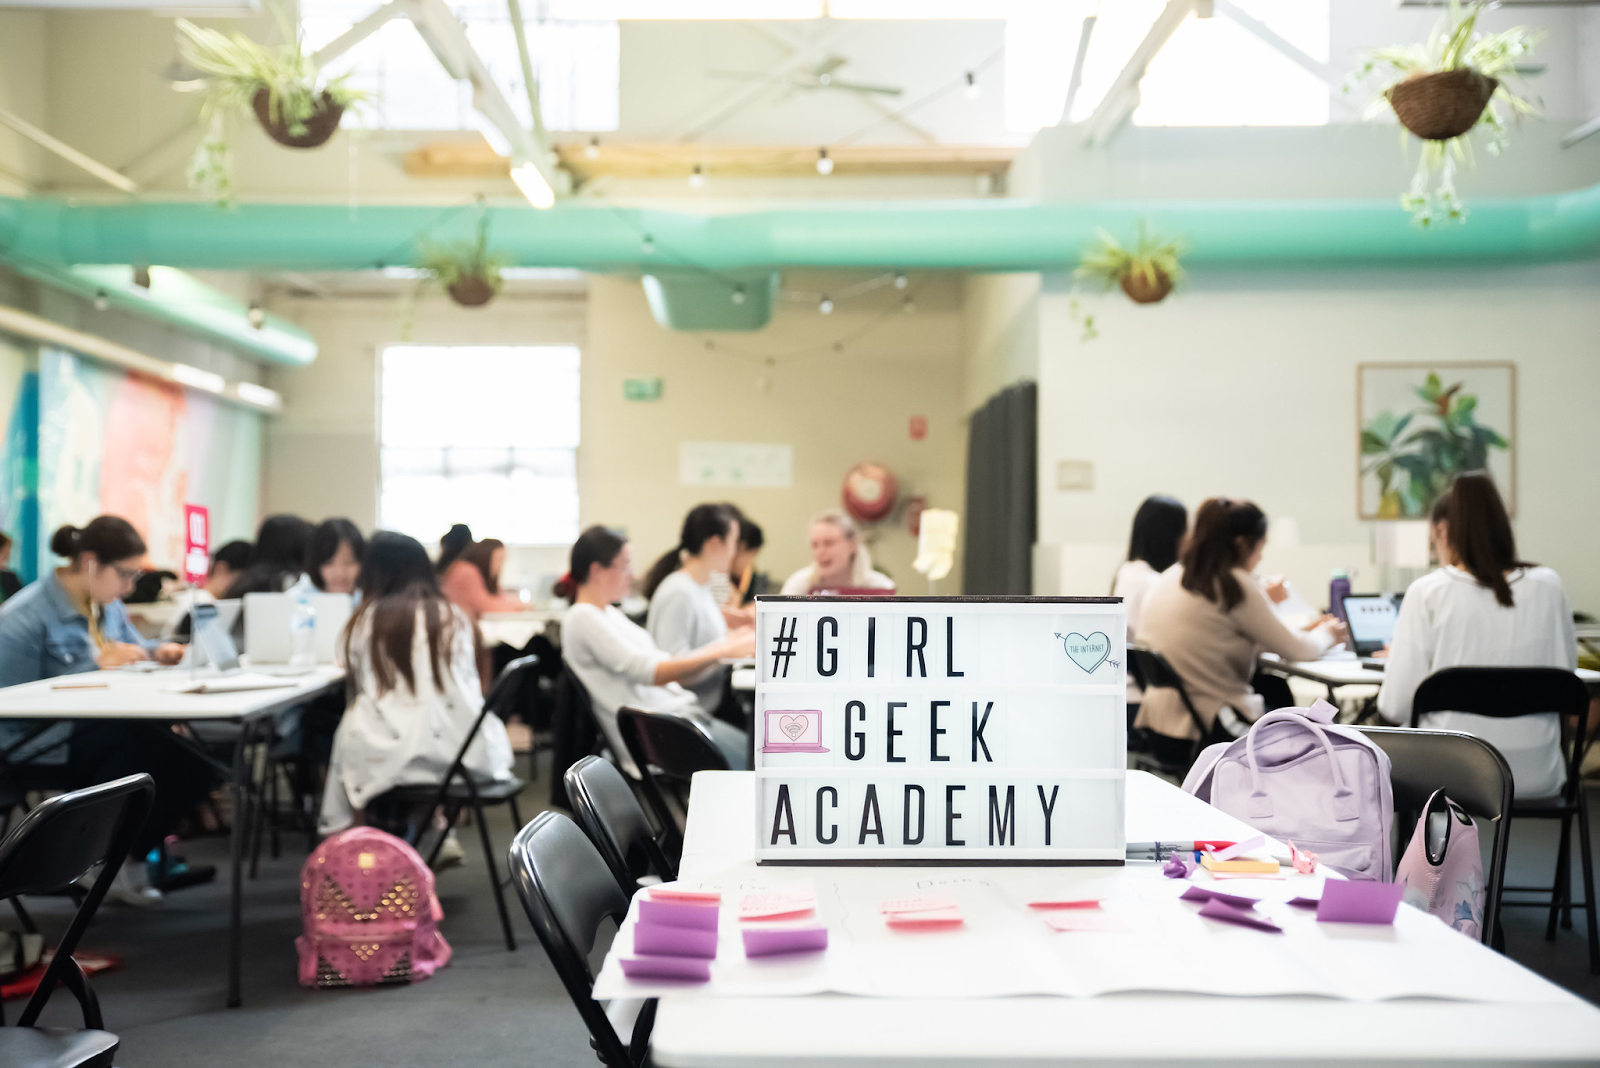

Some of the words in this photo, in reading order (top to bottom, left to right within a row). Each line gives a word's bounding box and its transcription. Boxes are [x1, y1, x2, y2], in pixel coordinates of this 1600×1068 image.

[771, 616, 965, 678] #GIRL
[1070, 645, 1079, 653] THE
[1080, 644, 1104, 653] INTERNET
[844, 700, 994, 763] GEEK
[770, 784, 1060, 847] ACADEMY
